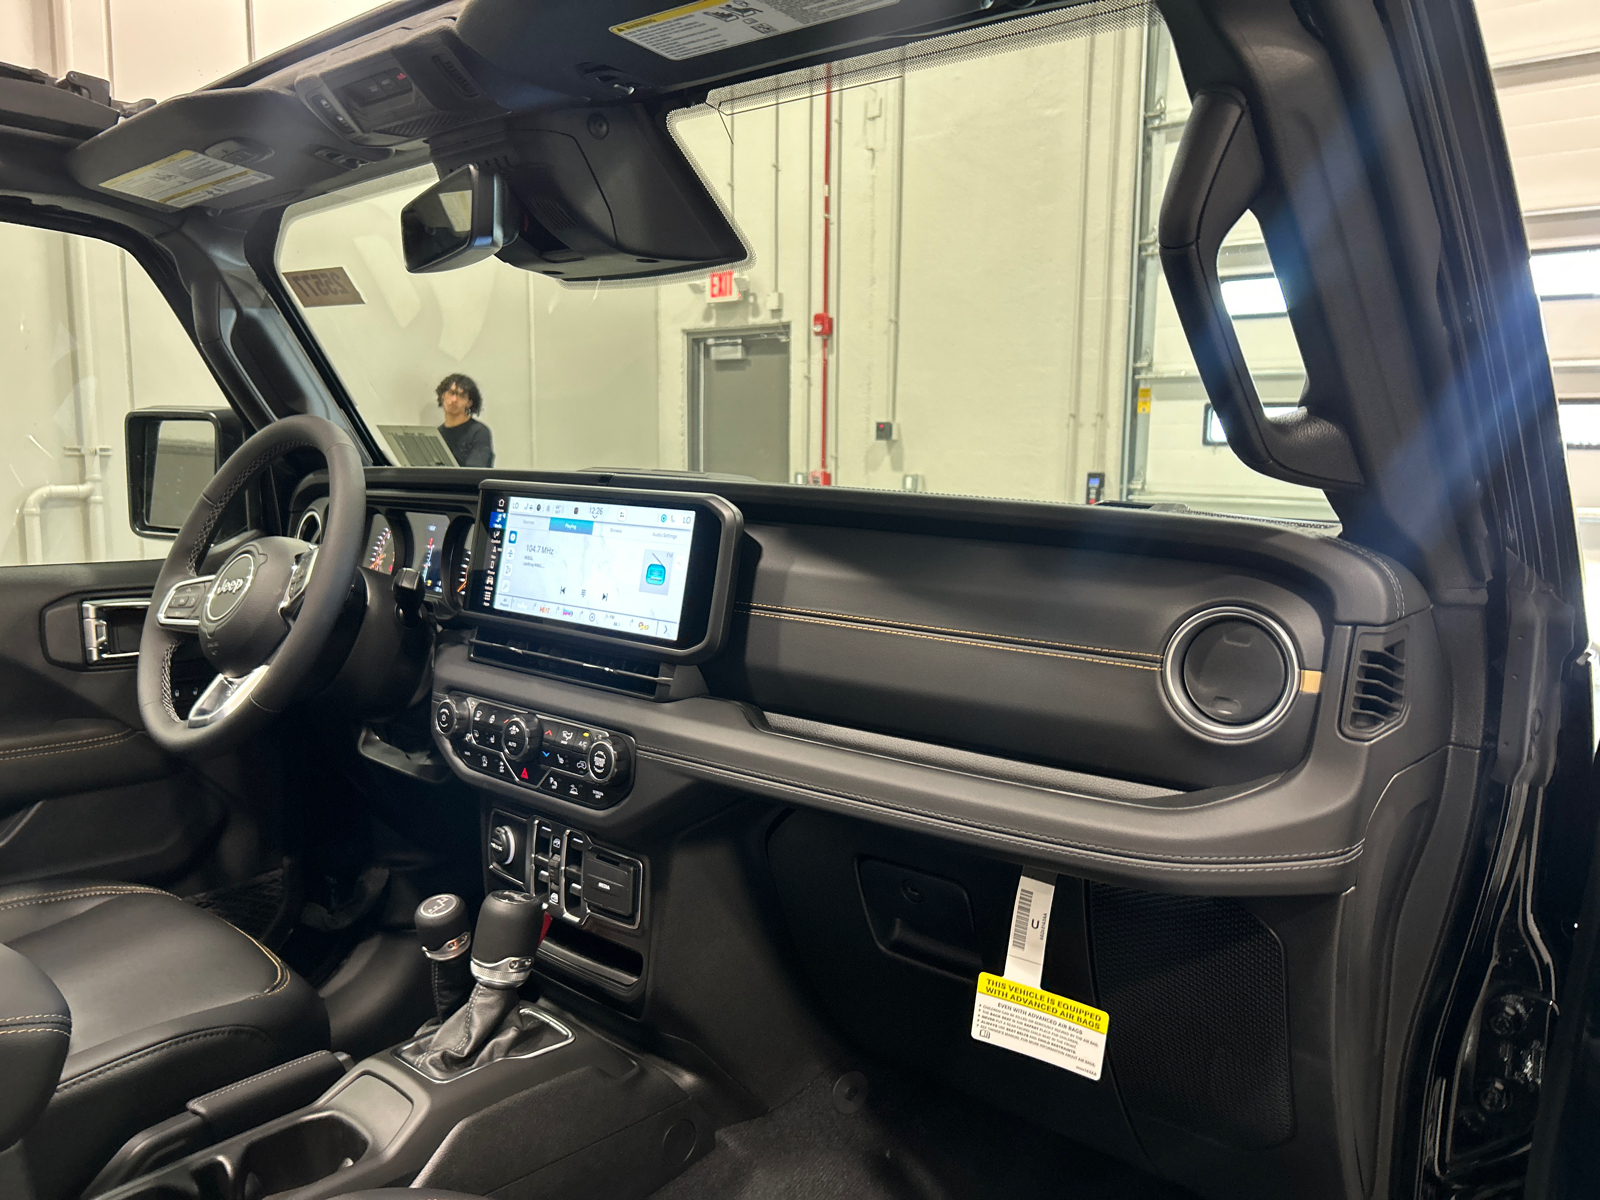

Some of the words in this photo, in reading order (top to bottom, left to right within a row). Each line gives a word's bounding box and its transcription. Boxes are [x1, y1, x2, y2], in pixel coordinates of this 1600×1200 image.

[710, 270, 734, 298] EXIT
[217, 578, 244, 595] Jeep
[1031, 918, 1040, 930] U
[986, 986, 1008, 999] WITH
[1010, 994, 1058, 1015] ADVANCED
[1060, 1010, 1075, 1020] AIR
[1077, 1016, 1100, 1030] BAGS
[987, 978, 1006, 990] THIS
[1008, 985, 1045, 1002] VEHICLE
[1047, 997, 1055, 1006] IS
[1057, 1001, 1102, 1022] EQUIPPED
[998, 1002, 1012, 1011] EVEN
[1013, 1007, 1027, 1016] WITH
[1028, 1012, 1057, 1026] ADVANCED
[1068, 1026, 1083, 1035] BAGS
